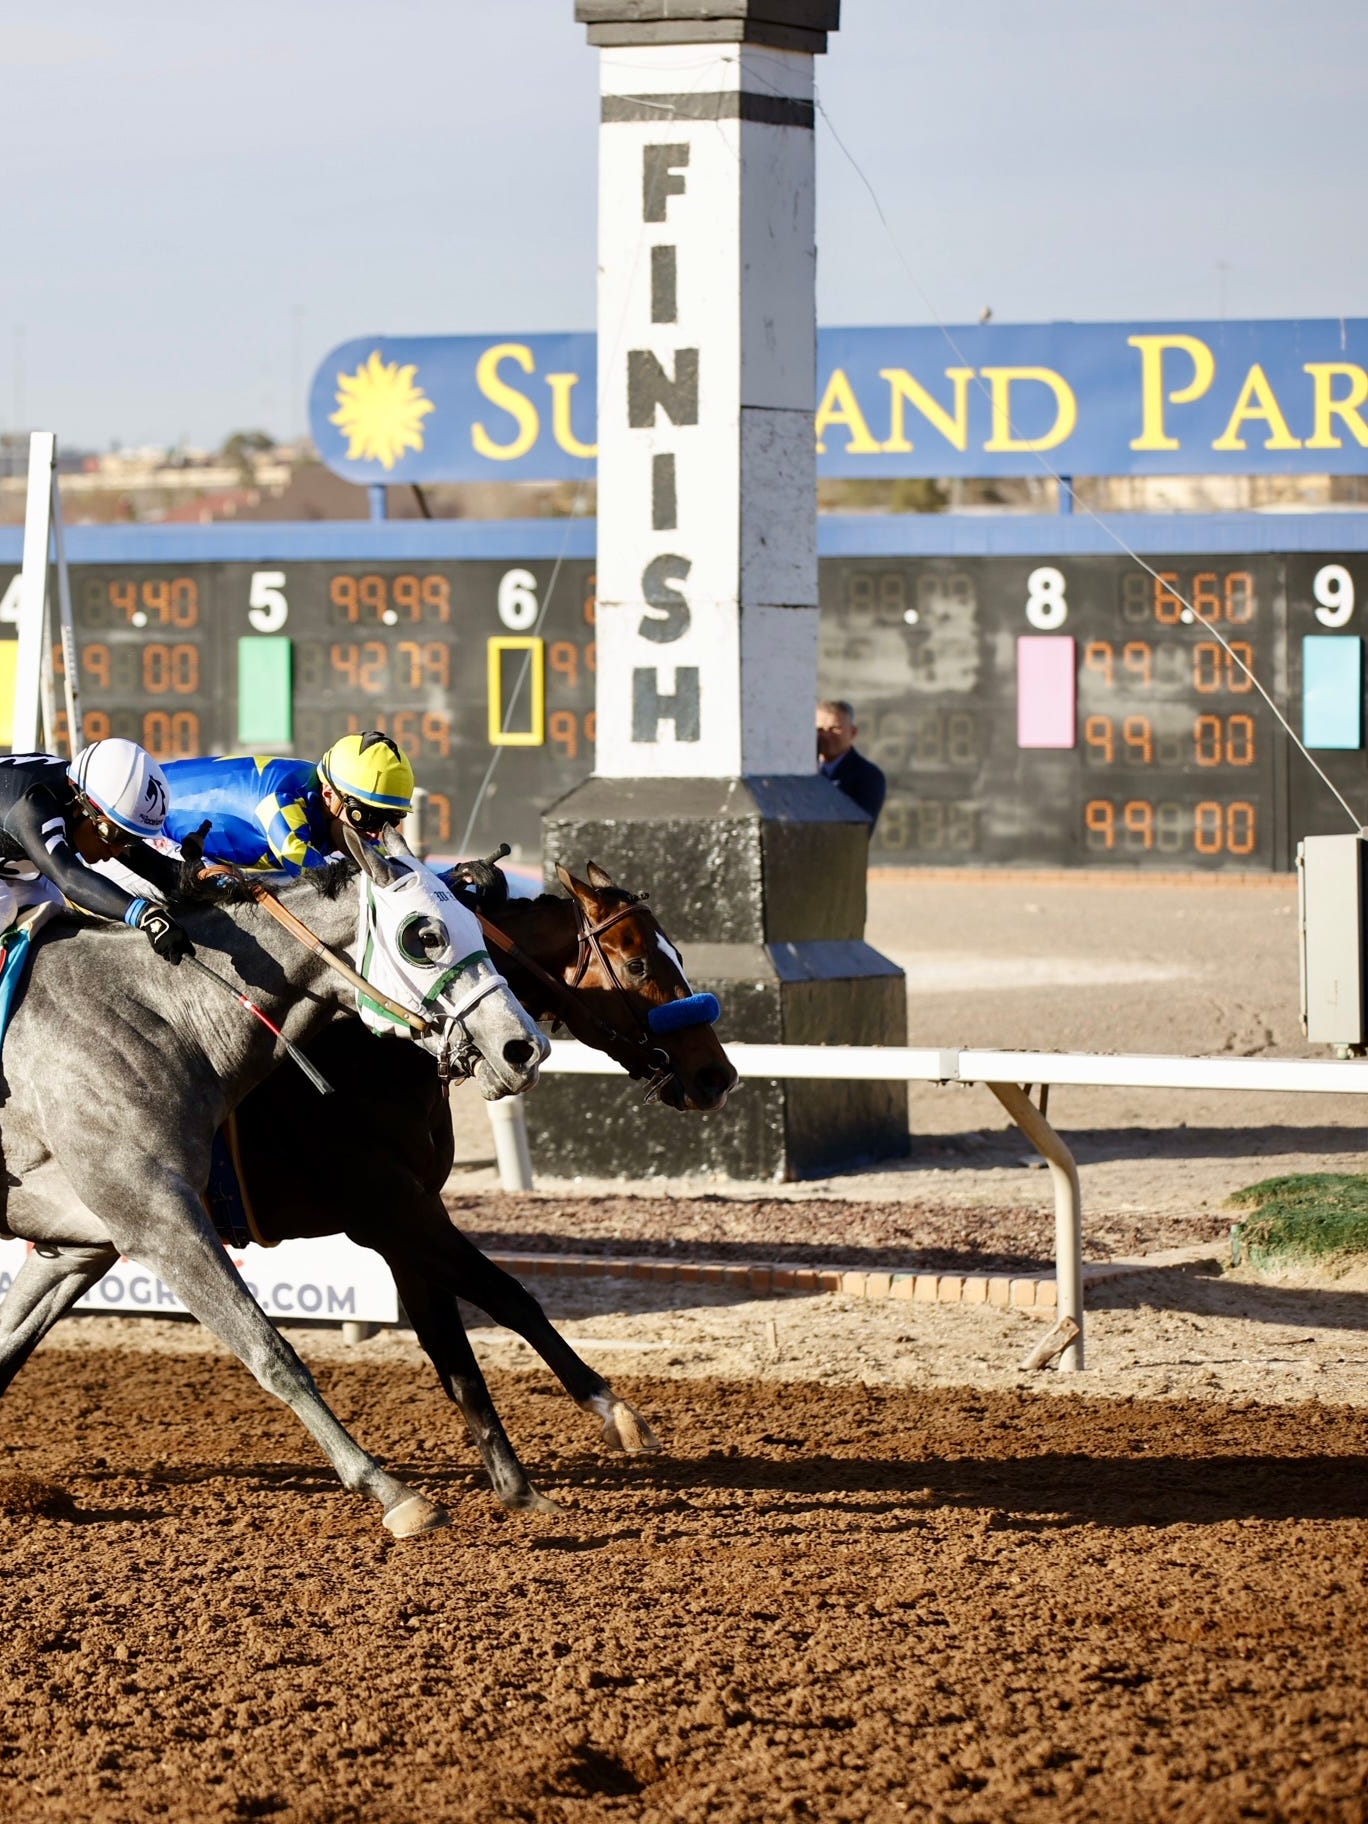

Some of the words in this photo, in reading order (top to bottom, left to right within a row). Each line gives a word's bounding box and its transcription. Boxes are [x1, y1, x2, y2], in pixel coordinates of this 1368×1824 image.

[472, 342, 1078, 459] SUAND
[626, 143, 701, 743] FINISH
[248, 571, 288, 633] 5
[497, 568, 538, 631] 6
[1025, 566, 1068, 630] 8
[1313, 564, 1355, 628] 9
